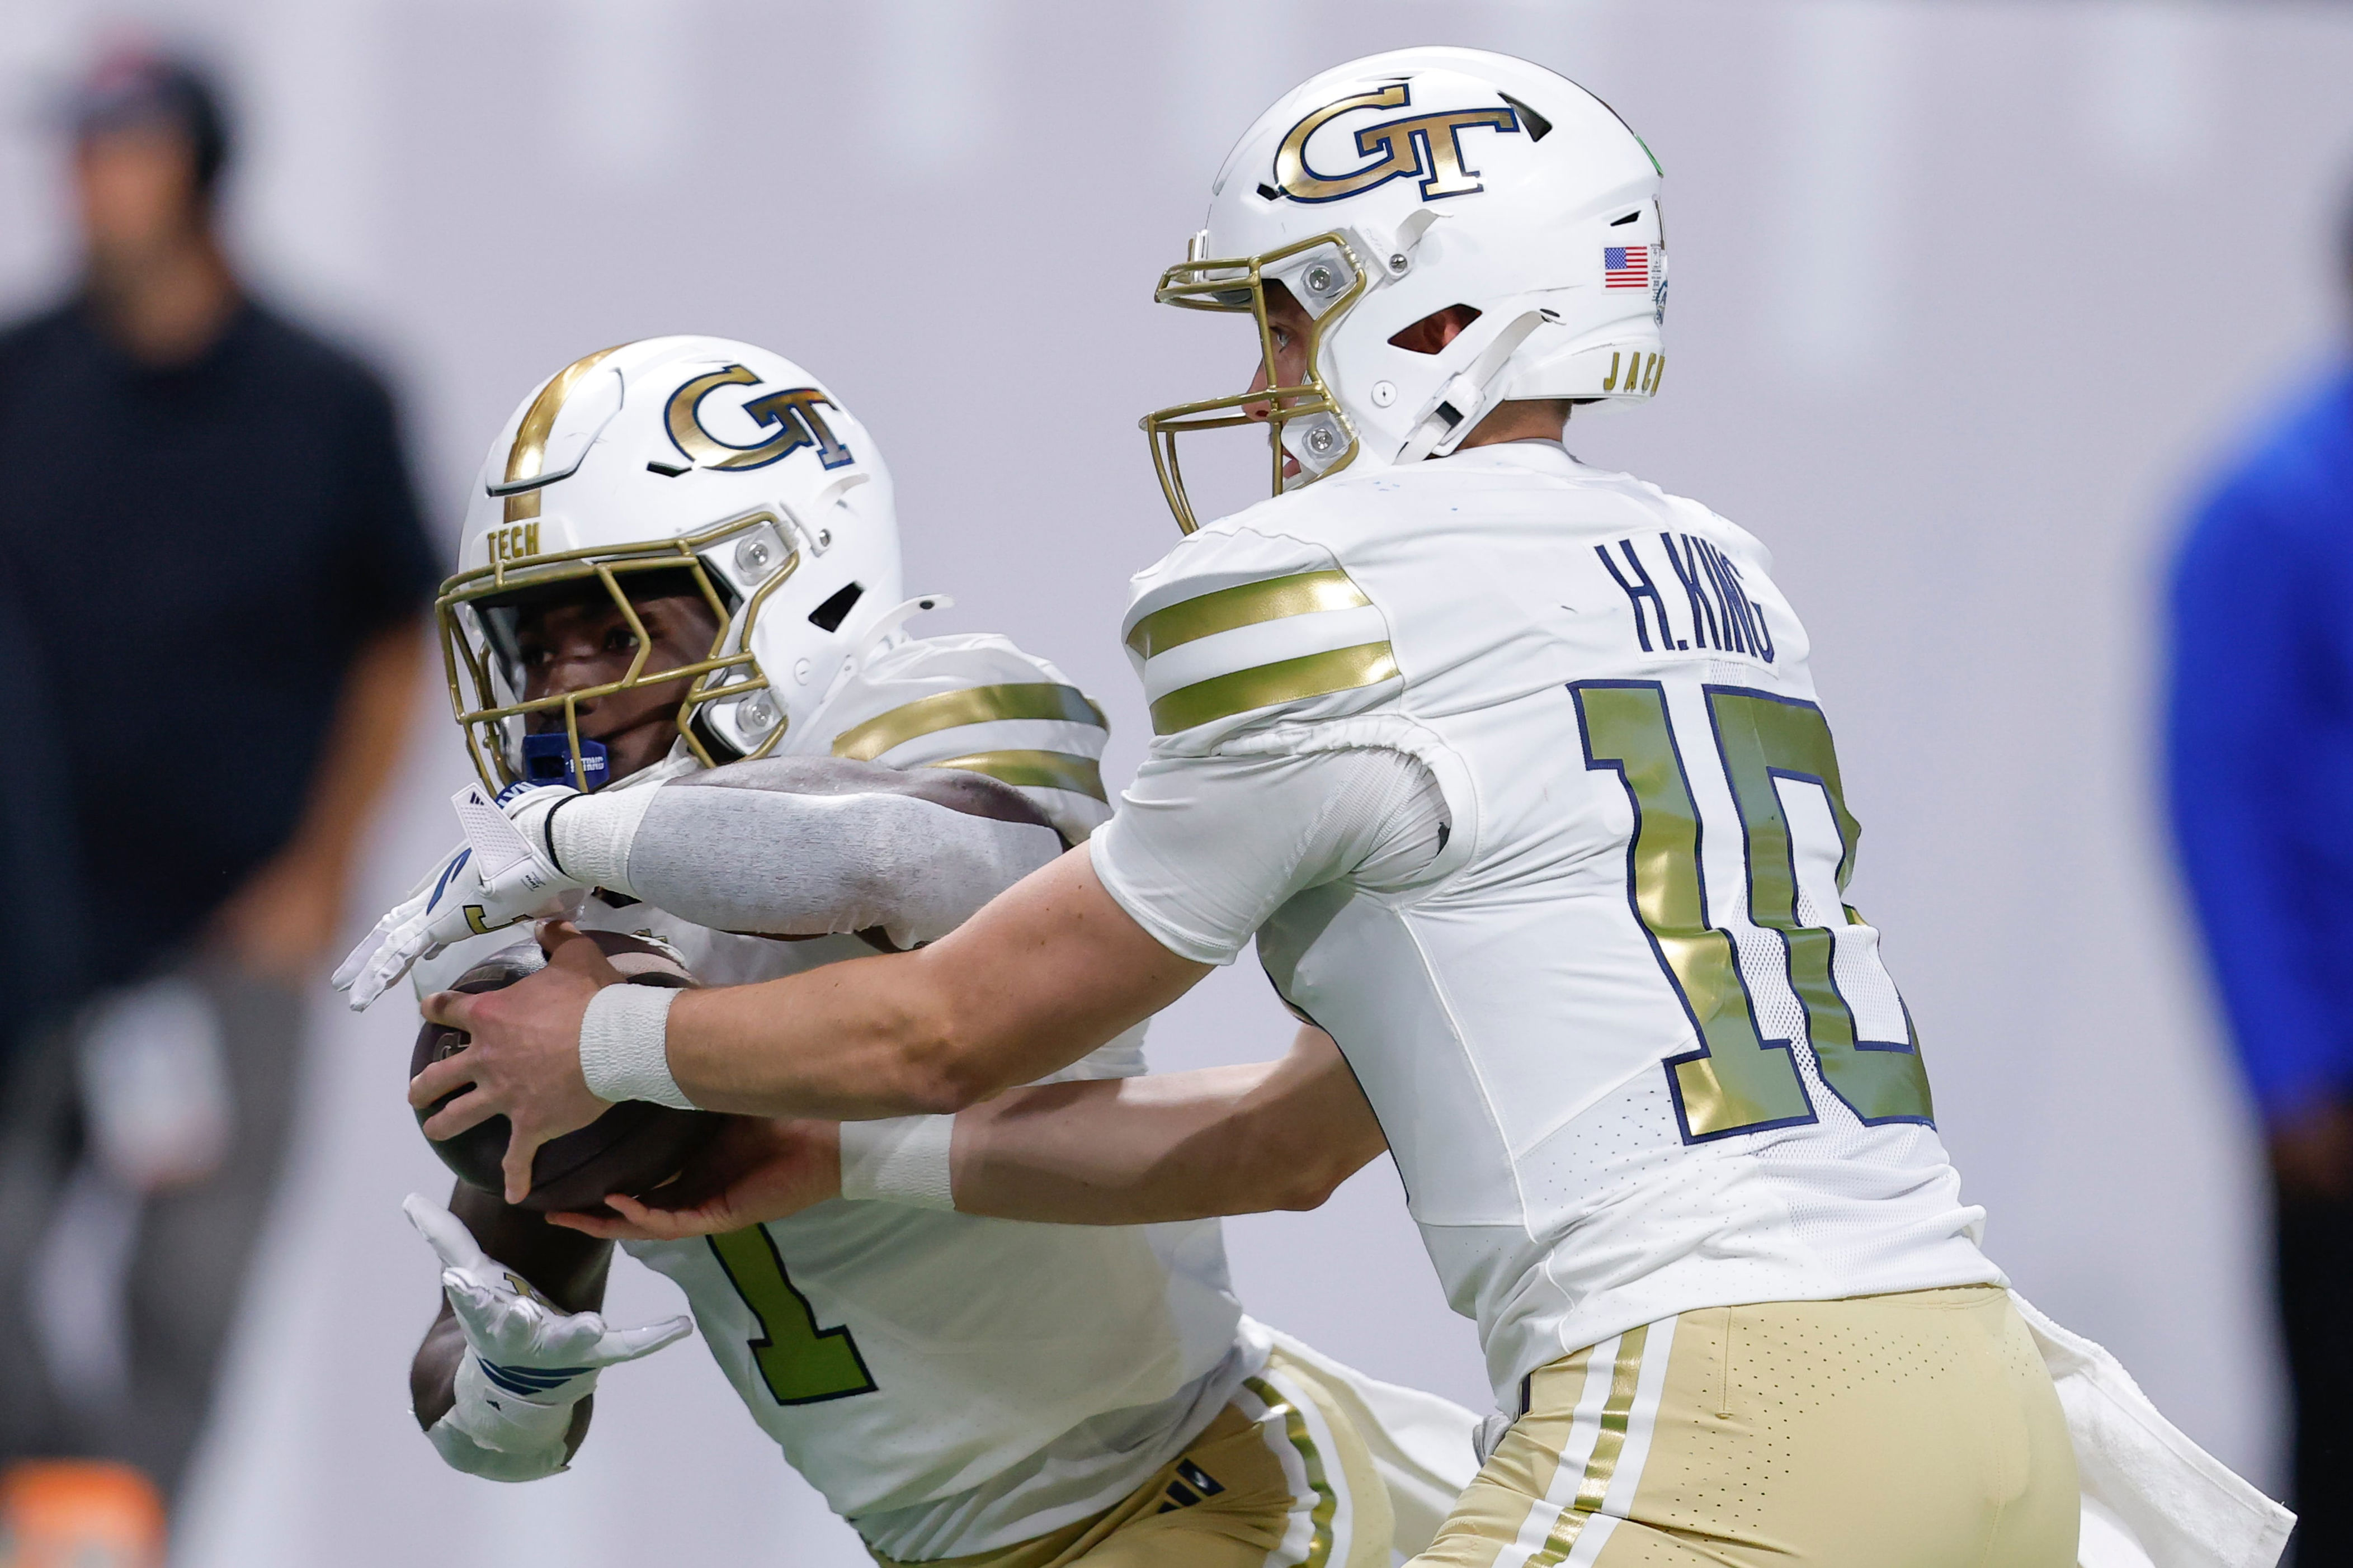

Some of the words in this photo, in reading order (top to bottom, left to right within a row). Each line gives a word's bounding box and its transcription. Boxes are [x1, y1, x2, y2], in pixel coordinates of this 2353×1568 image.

[1272, 83, 1520, 204] GT
[663, 363, 856, 471] GT
[487, 522, 540, 564] TECH
[1594, 532, 1775, 664] H.KING
[1566, 679, 1938, 1146] 10
